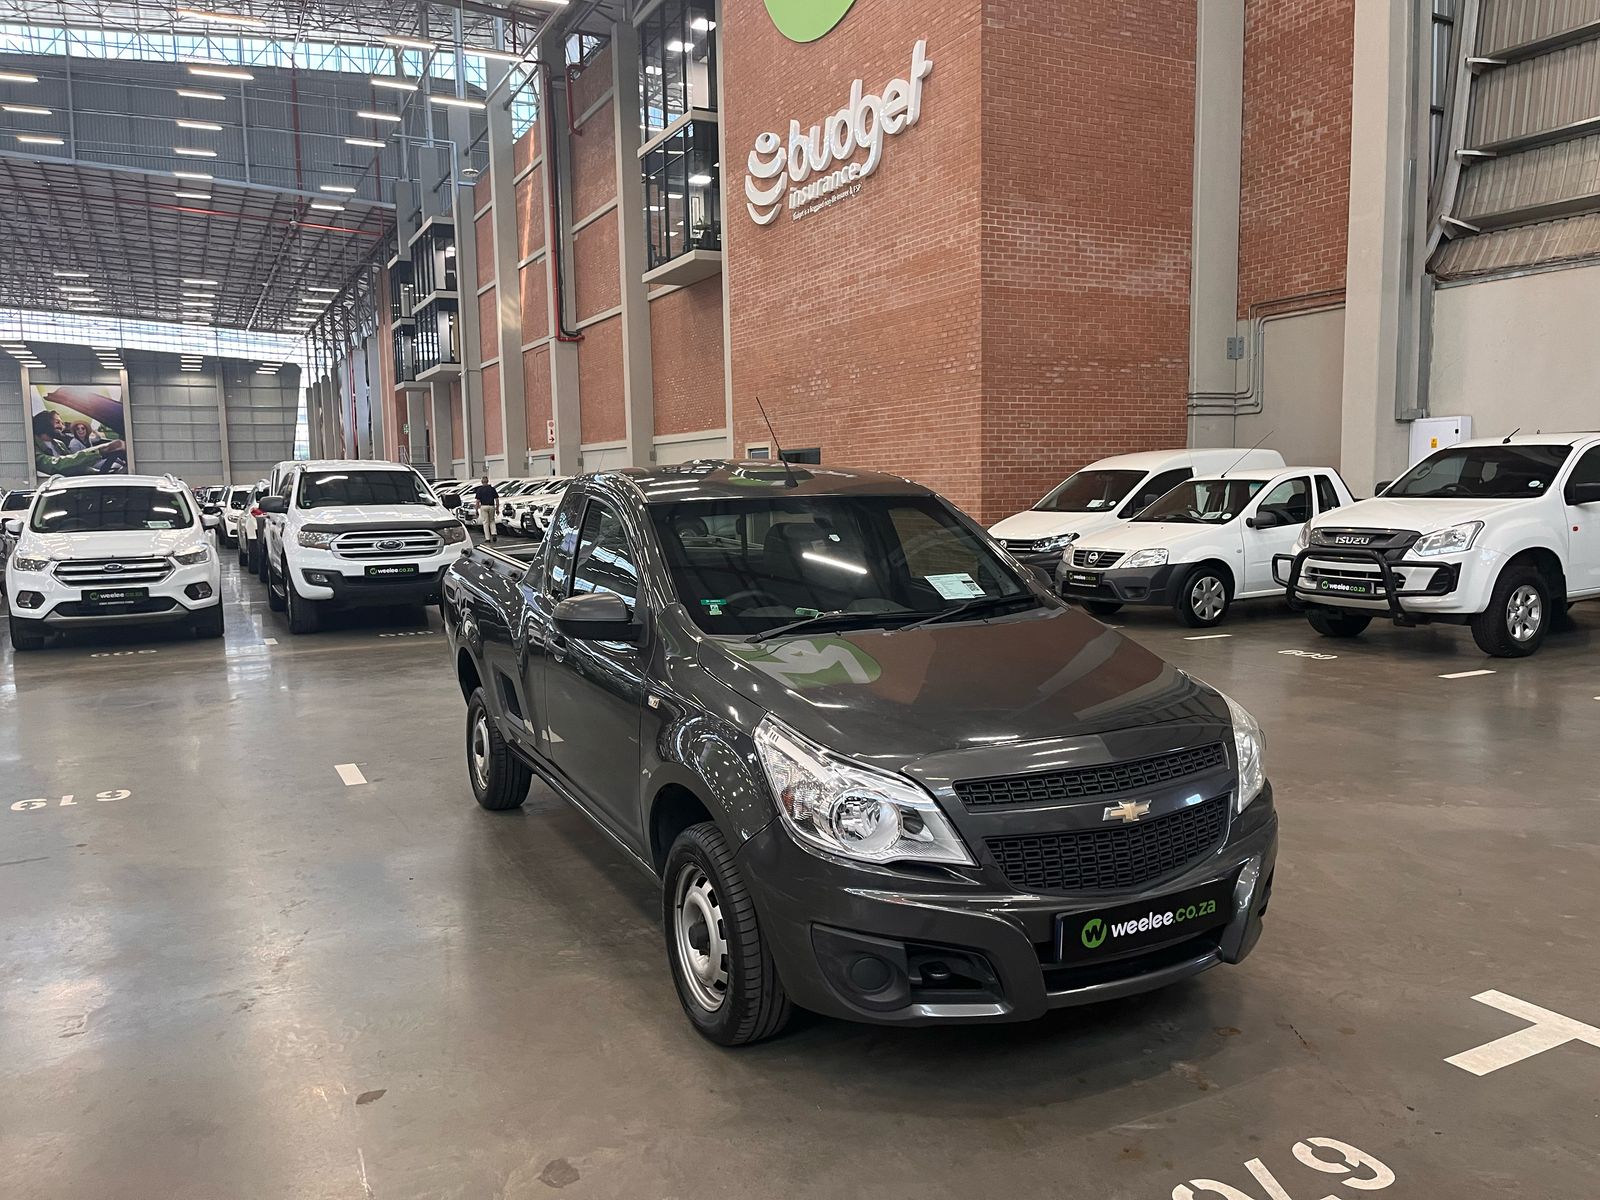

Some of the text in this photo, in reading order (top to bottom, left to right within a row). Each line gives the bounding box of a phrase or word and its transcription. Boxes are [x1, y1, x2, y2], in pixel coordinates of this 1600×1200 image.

[788, 39, 933, 182] budget
[789, 162, 861, 209] insurance
[1335, 536, 1370, 545] ISUZU
[10, 788, 132, 812] 619
[1111, 899, 1216, 938] weelee.co.za
